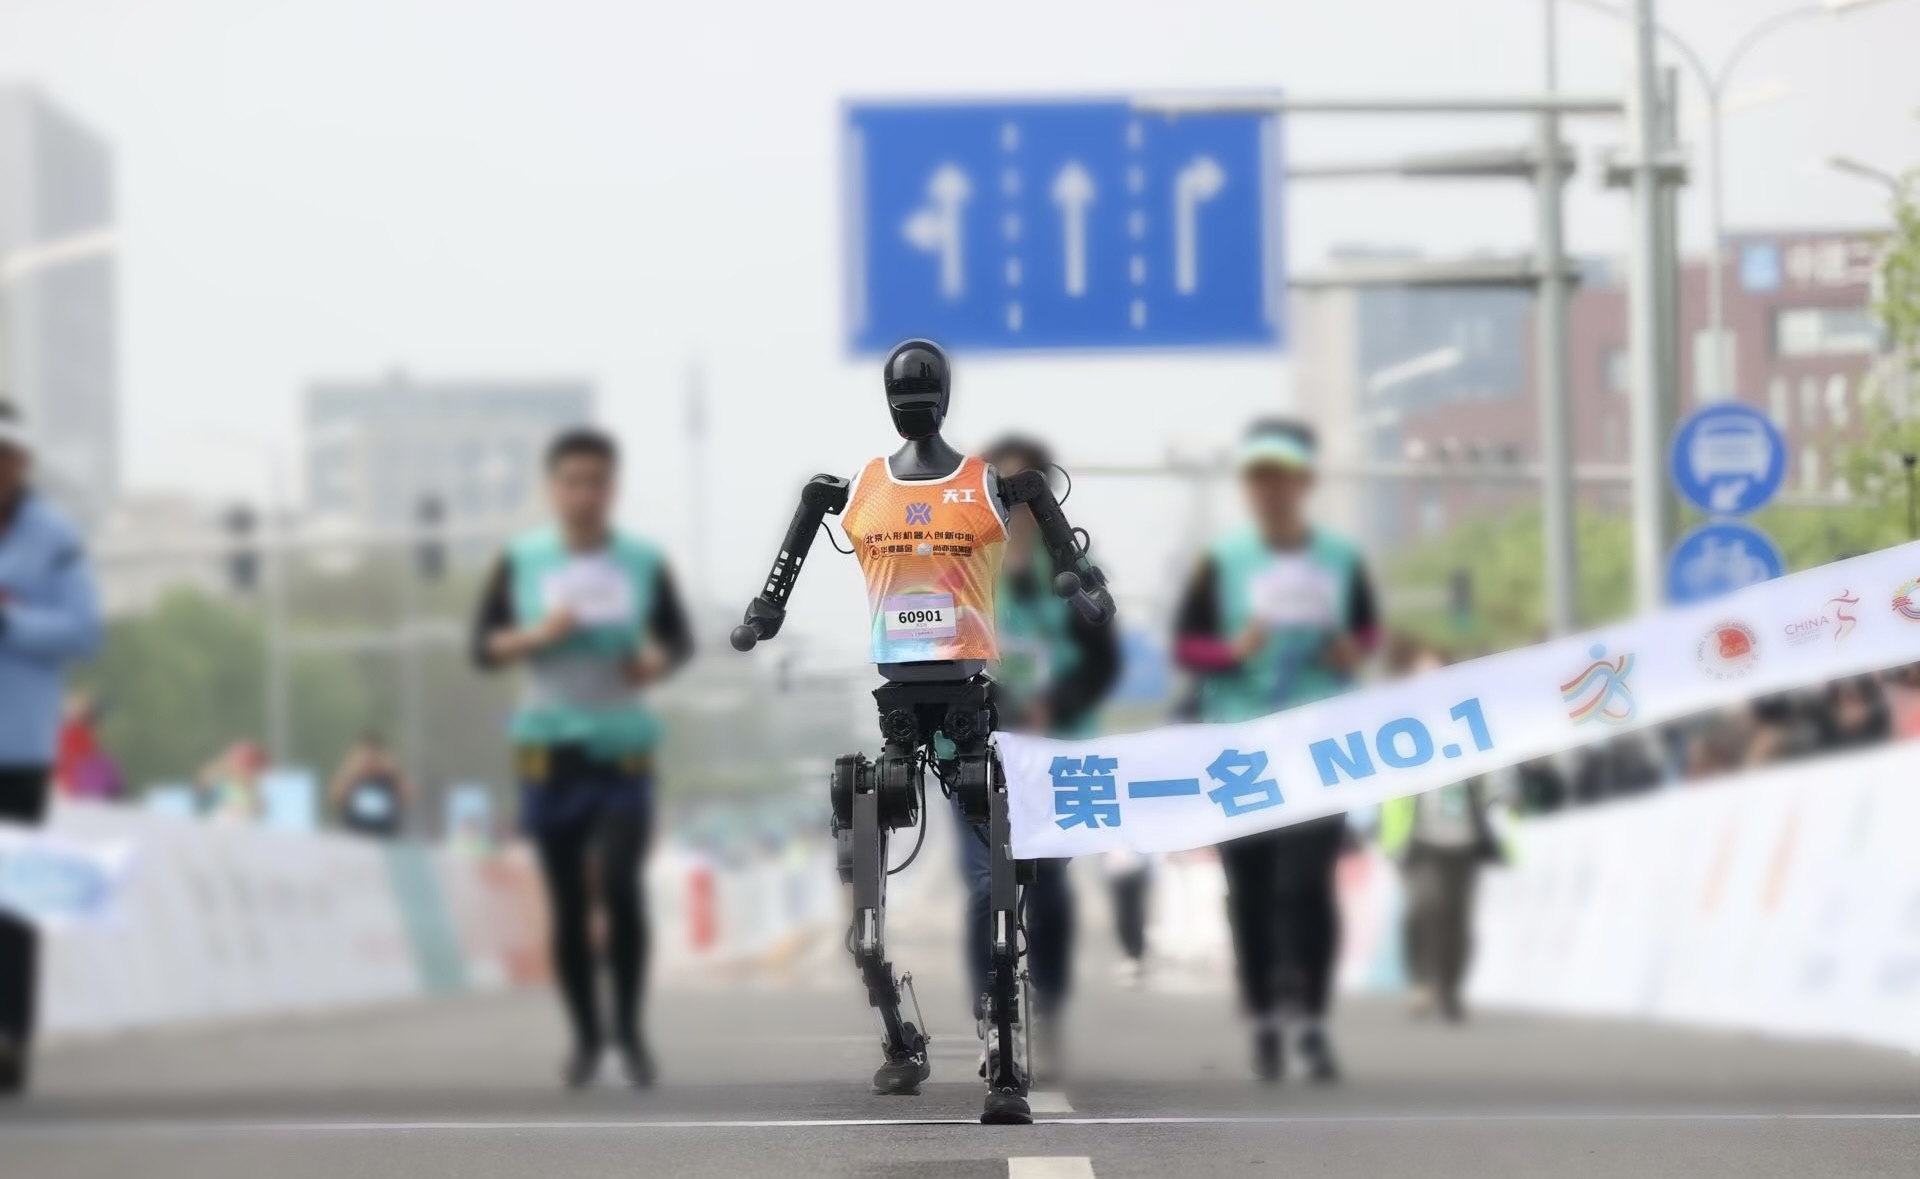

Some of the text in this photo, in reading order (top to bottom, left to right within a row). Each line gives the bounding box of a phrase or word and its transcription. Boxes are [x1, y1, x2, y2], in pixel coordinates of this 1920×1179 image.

[942, 488, 977, 504] 天工
[866, 531, 974, 544] 北京人形机器人创新中心
[898, 610, 943, 623] 60901
[1784, 615, 1830, 635] CHINA
[1048, 697, 1494, 830] 第一名 NO.1
